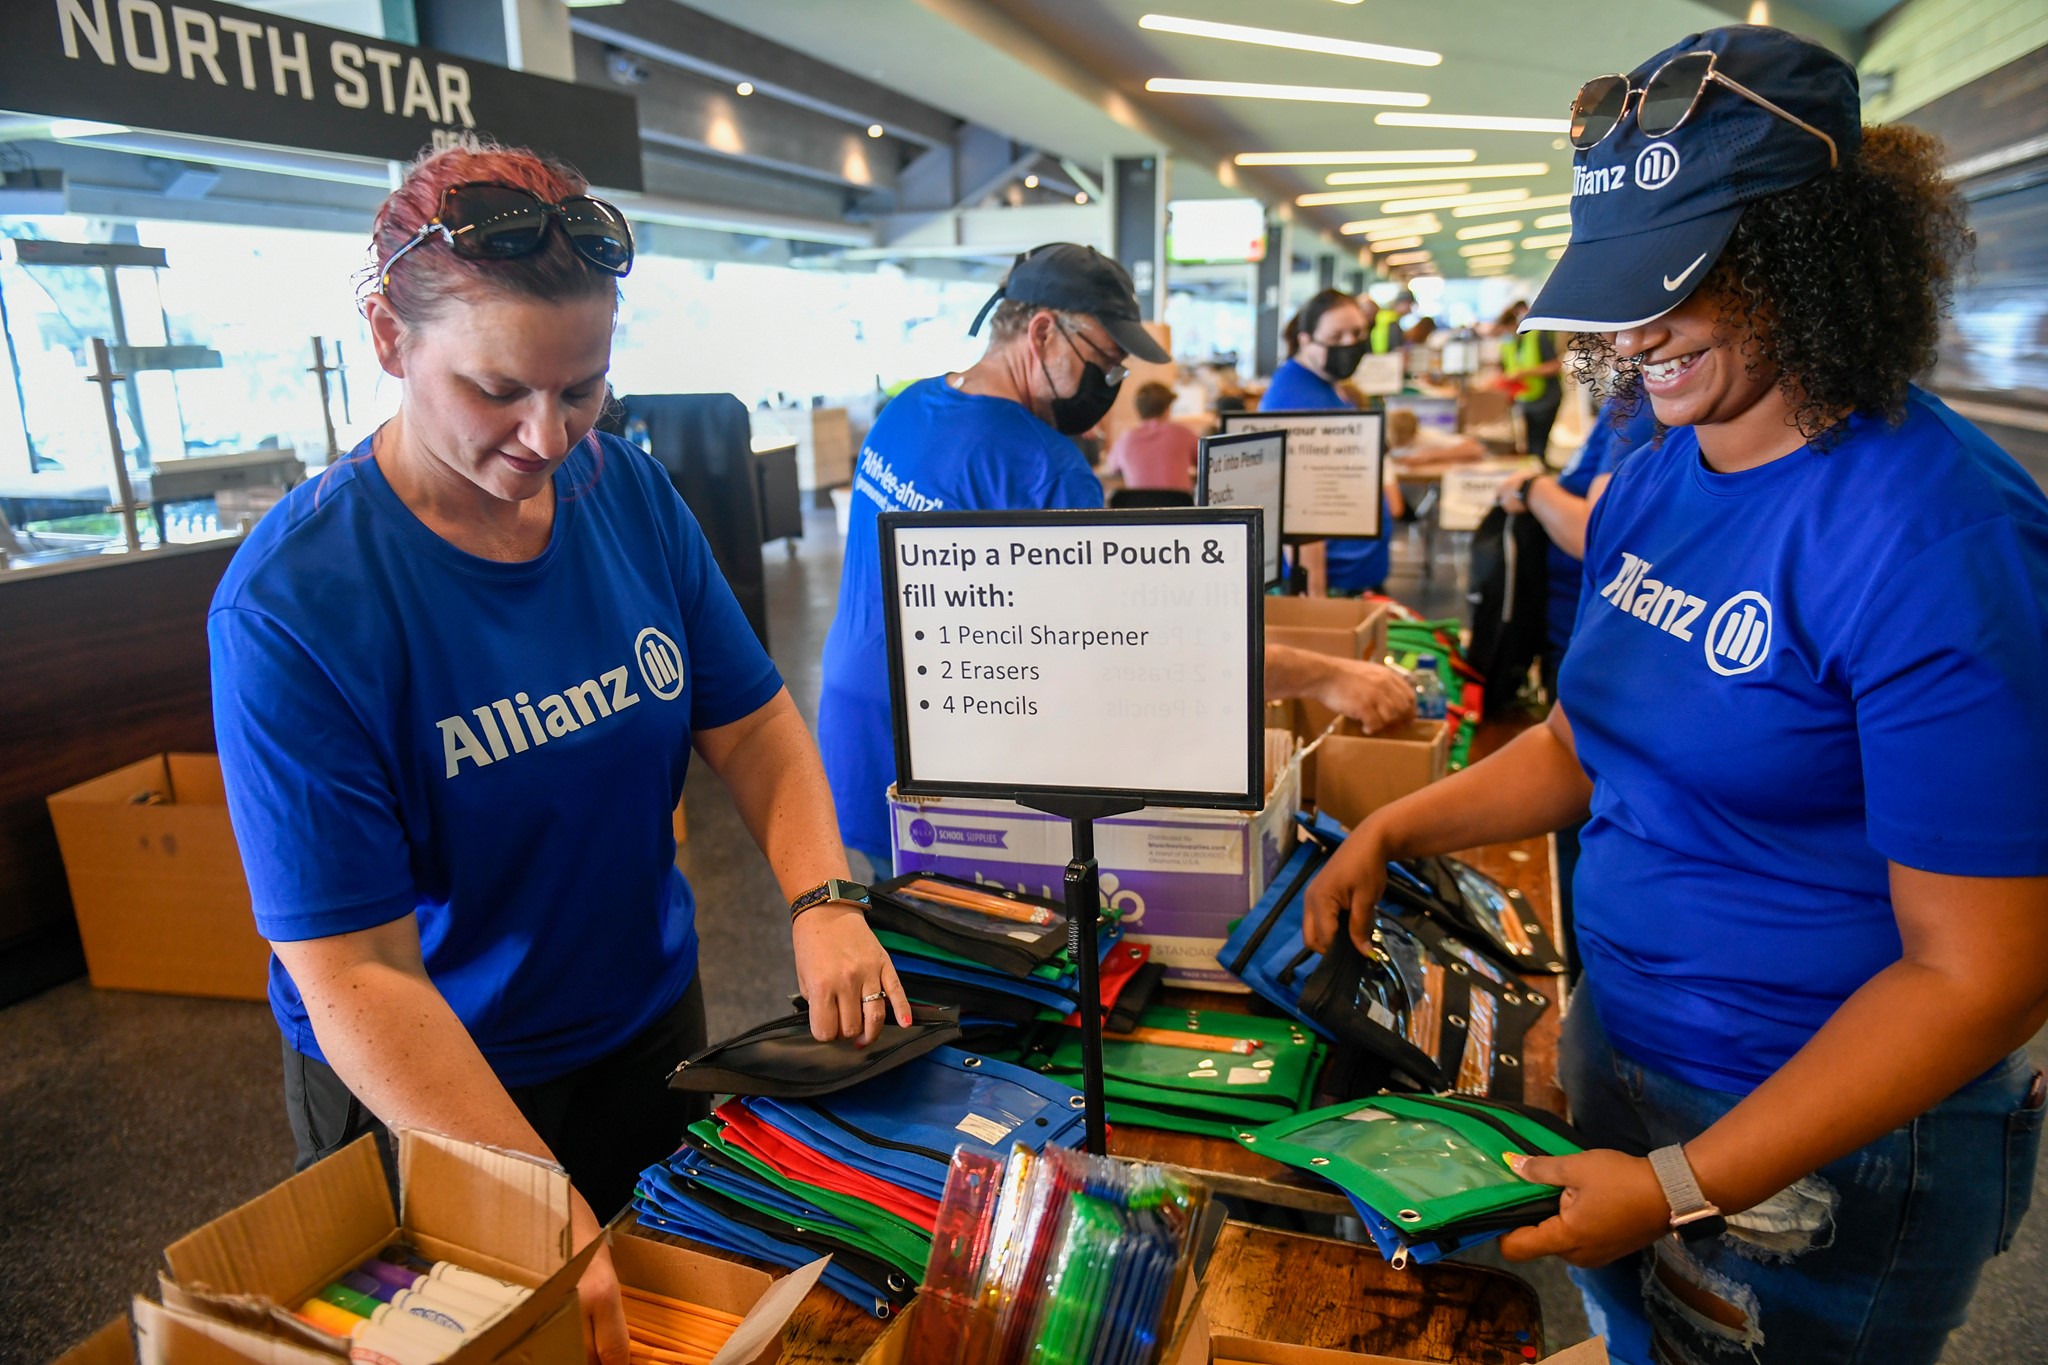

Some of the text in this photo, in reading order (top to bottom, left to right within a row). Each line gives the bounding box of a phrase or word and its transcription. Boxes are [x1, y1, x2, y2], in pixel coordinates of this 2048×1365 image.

[56, 0, 476, 129] NORTH STAR
[1573, 165, 1626, 196] llianz
[1223, 454, 1239, 472] into
[1241, 448, 1264, 468] Pencil
[900, 539, 1225, 571] Unzip a Pencil Pouch &
[903, 583, 1014, 608] fill with:
[1600, 552, 1707, 642] Allanz
[939, 626, 951, 644] 1
[958, 626, 1023, 645] Pencil
[1031, 626, 1149, 650] Sharpener
[941, 661, 1040, 680] 2 Erasers
[942, 695, 1038, 715] 4 Pencils
[436, 665, 640, 779] Allianz
[939, 830, 997, 843] SCHOOL SUPPLIES
[1156, 945, 1218, 957] STANDAR
